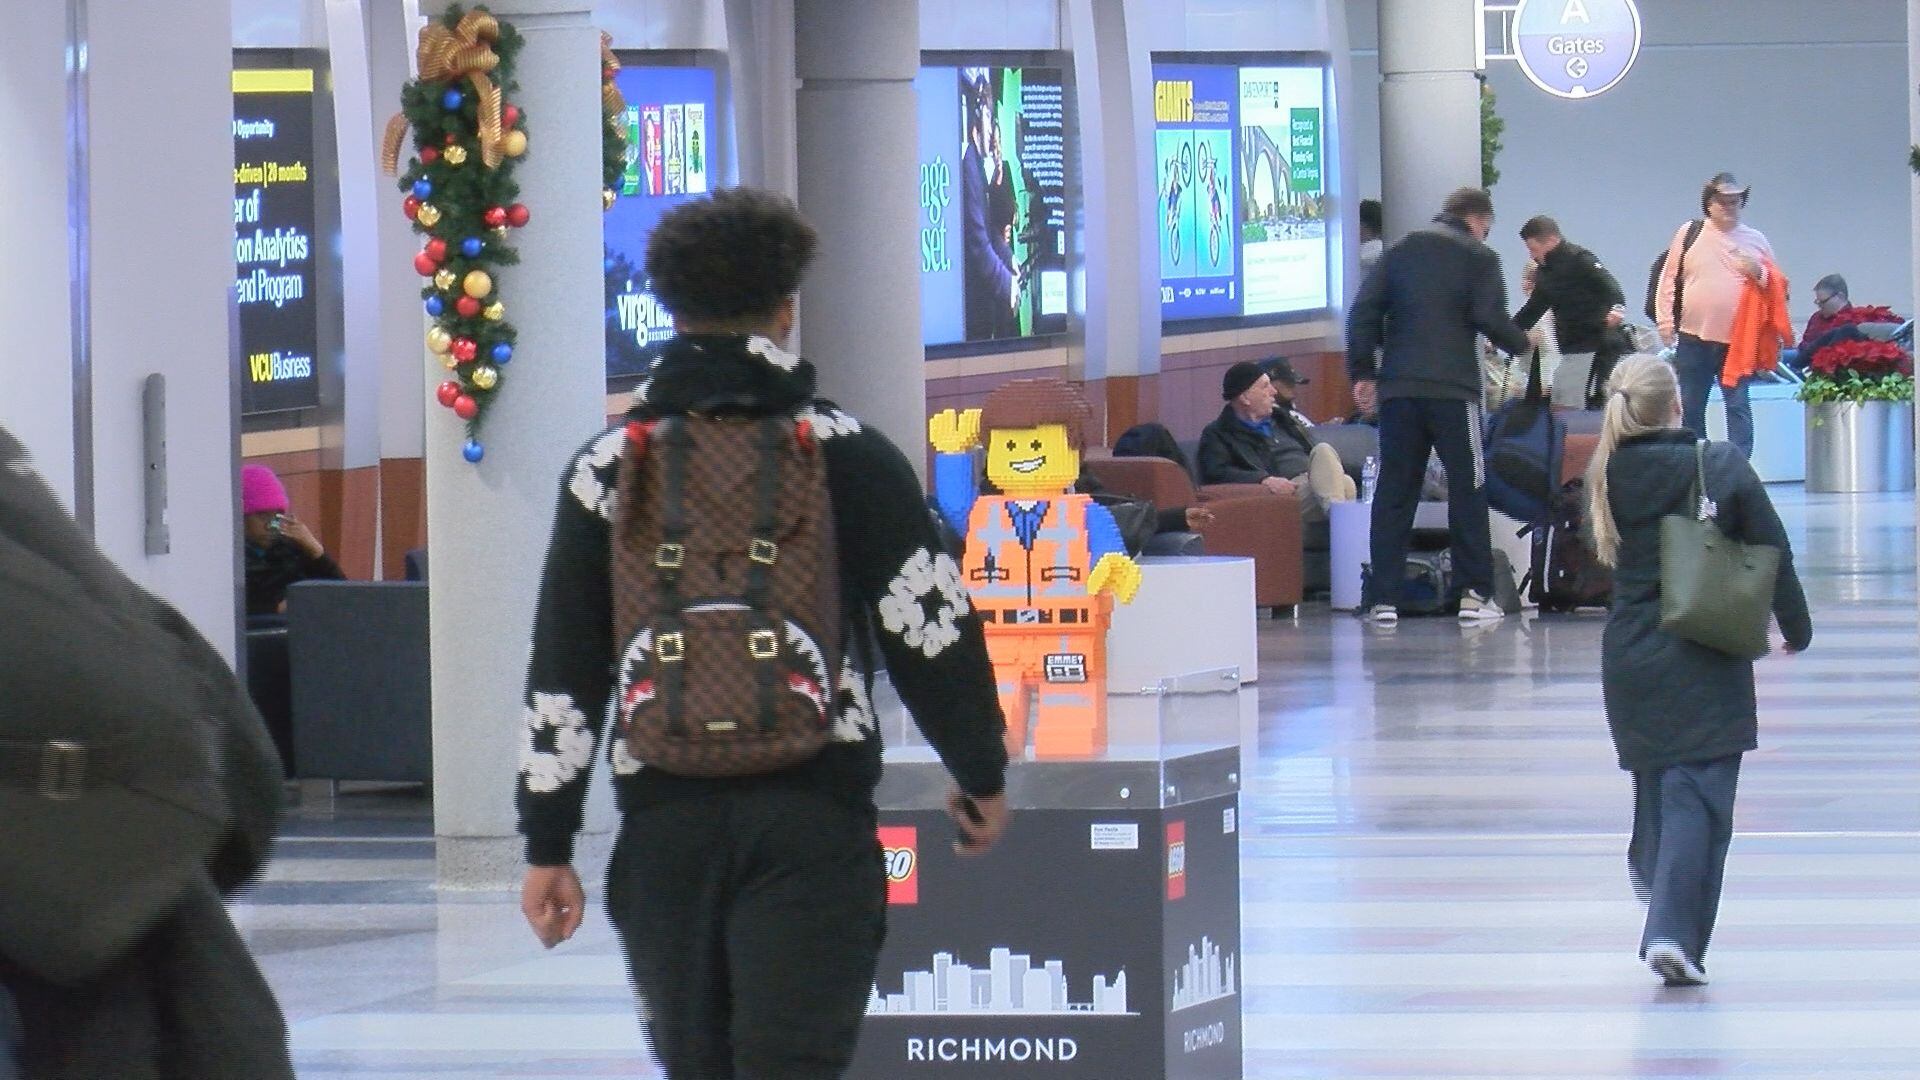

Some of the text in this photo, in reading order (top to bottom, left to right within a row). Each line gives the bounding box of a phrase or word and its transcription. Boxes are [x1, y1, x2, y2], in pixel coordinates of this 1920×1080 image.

[1560, 0, 1590, 25] A
[1547, 36, 1605, 55] Gates
[1155, 80, 1193, 122] GIANTS
[237, 119, 274, 139] Opportunity
[268, 161, 278, 182] 20
[278, 160, 307, 181] months
[246, 188, 260, 222] of
[920, 155, 951, 224] age
[254, 227, 308, 268] Analytics
[921, 217, 951, 273] set.
[257, 268, 303, 308] Program
[907, 1037, 1078, 1062] RICHMOND
[1183, 1021, 1224, 1054] RICHMOND
